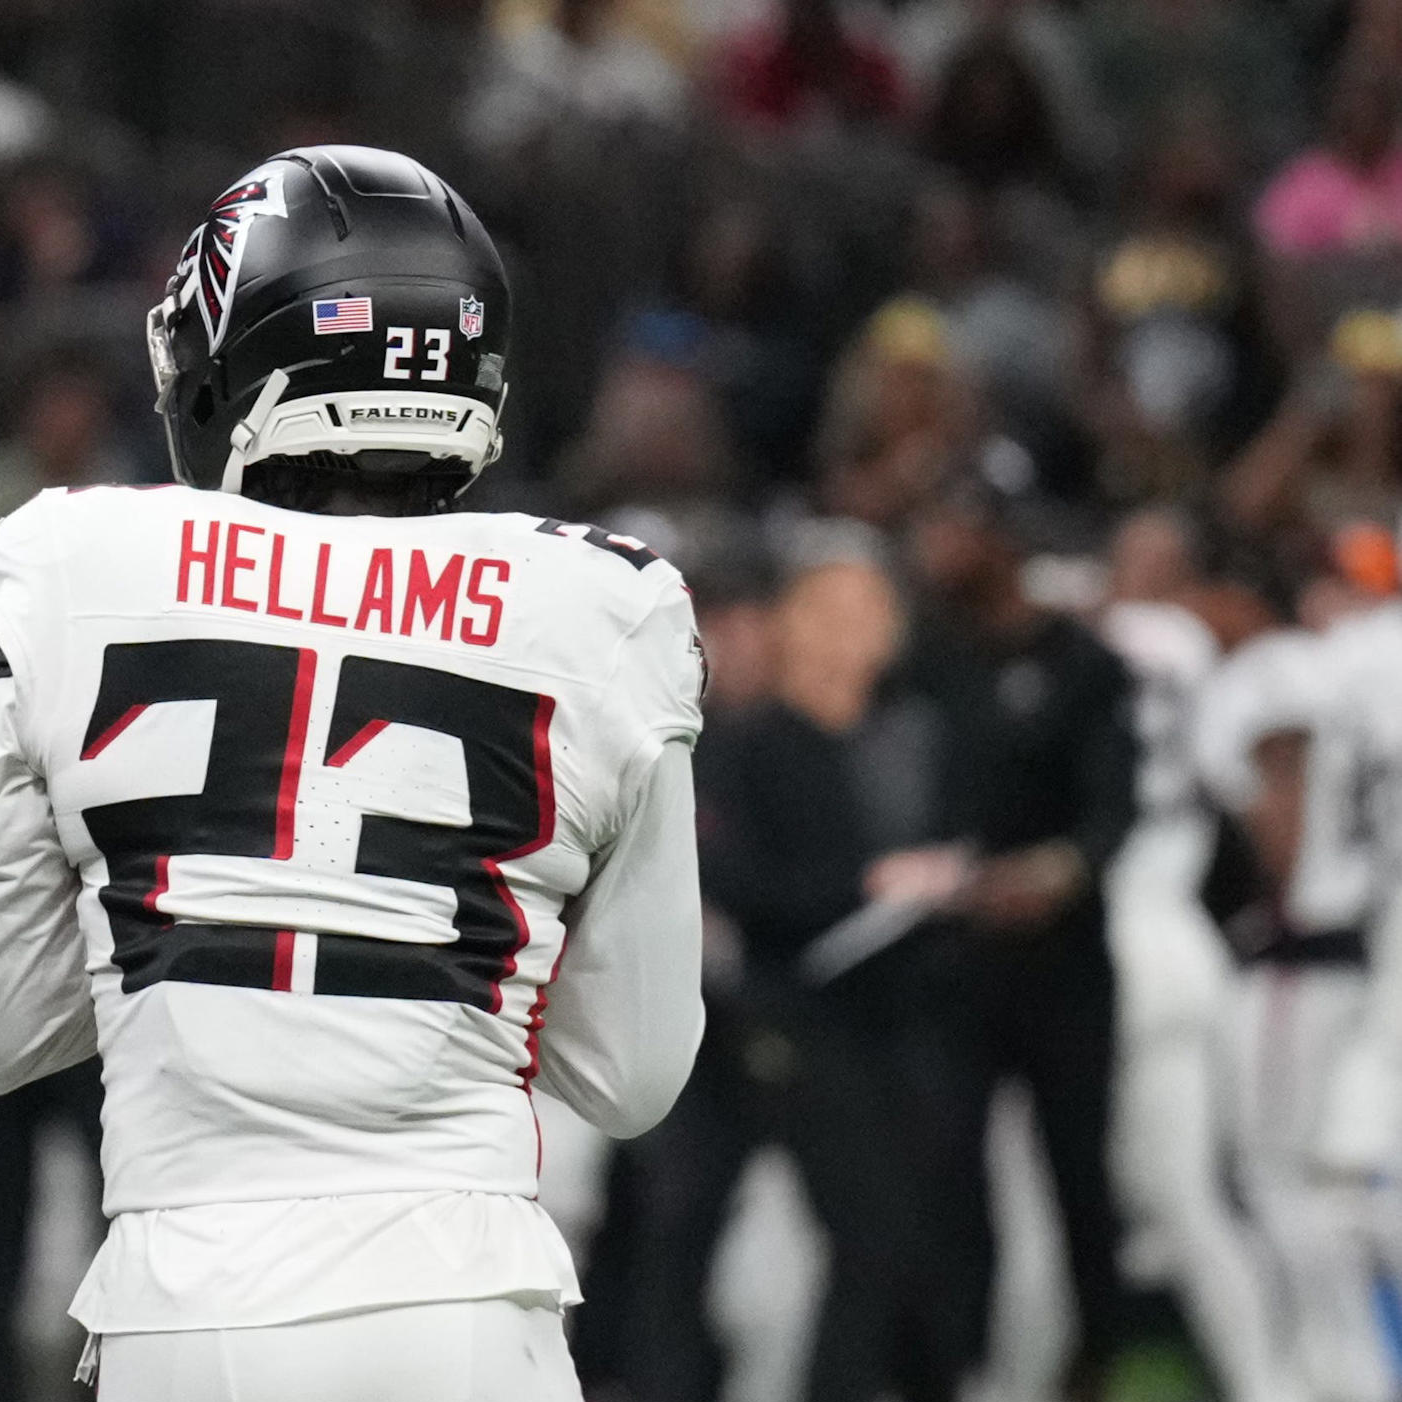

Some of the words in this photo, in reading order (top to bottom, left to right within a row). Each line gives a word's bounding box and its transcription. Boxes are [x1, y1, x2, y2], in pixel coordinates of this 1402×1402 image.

[463, 315, 482, 333] NFL
[383, 326, 452, 381] 23
[350, 406, 458, 422] FALCONS
[175, 519, 510, 647] HELLAMS
[80, 637, 557, 1014] 23
